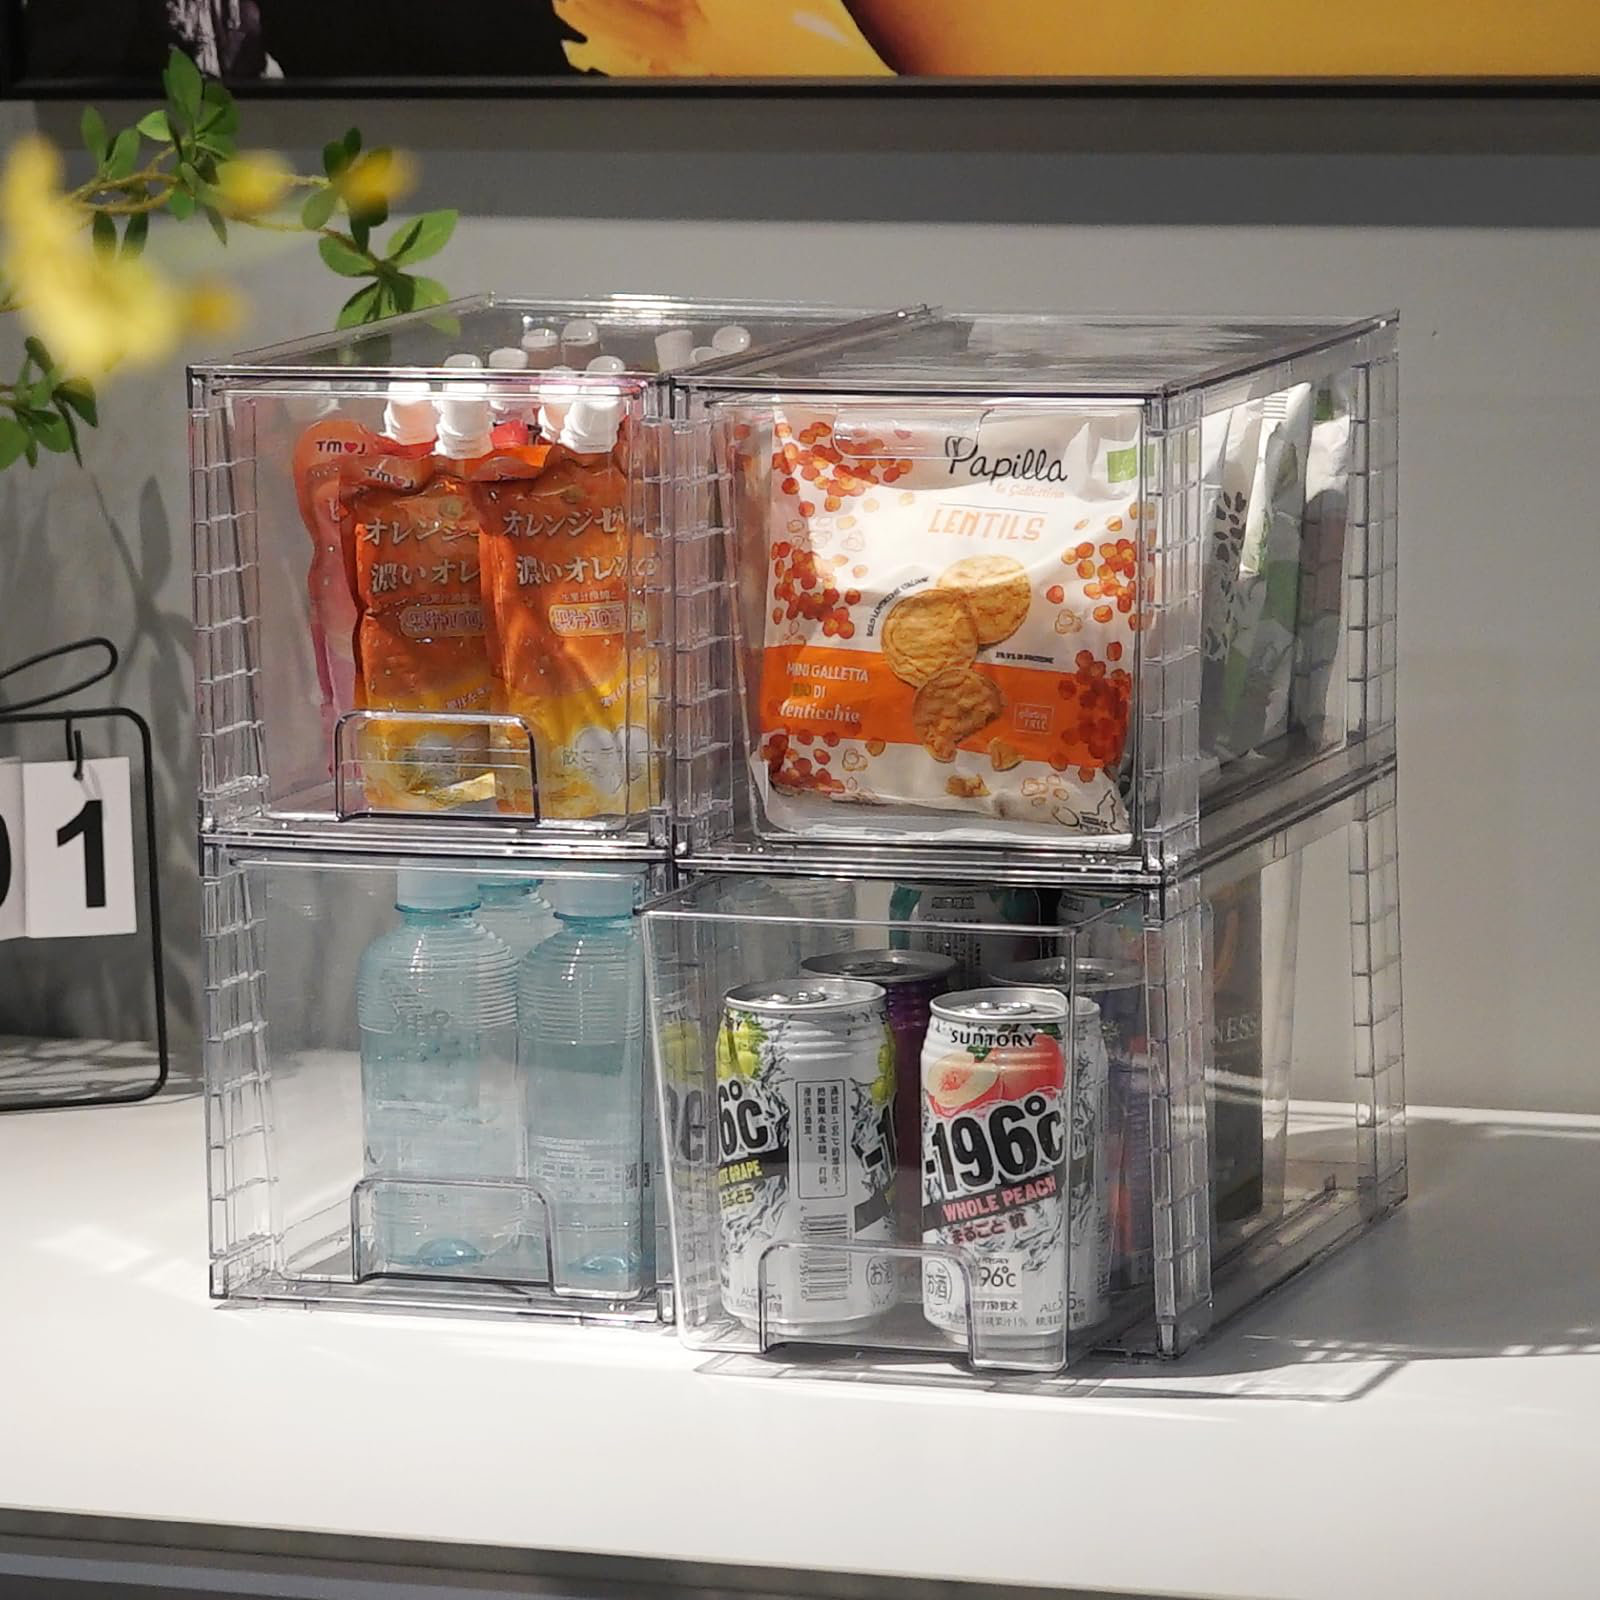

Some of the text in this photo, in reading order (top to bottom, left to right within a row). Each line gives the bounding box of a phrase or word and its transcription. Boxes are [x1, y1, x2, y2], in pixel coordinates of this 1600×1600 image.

[945, 435, 1068, 485] Papilla
[928, 509, 1045, 541] LENTILS
[811, 664, 869, 684] GALLETTA
[813, 684, 826, 699] DI
[57, 799, 106, 908] 1
[951, 1030, 1036, 1047] SUNTORY
[943, 1175, 1057, 1222] WHOLE PEACH
